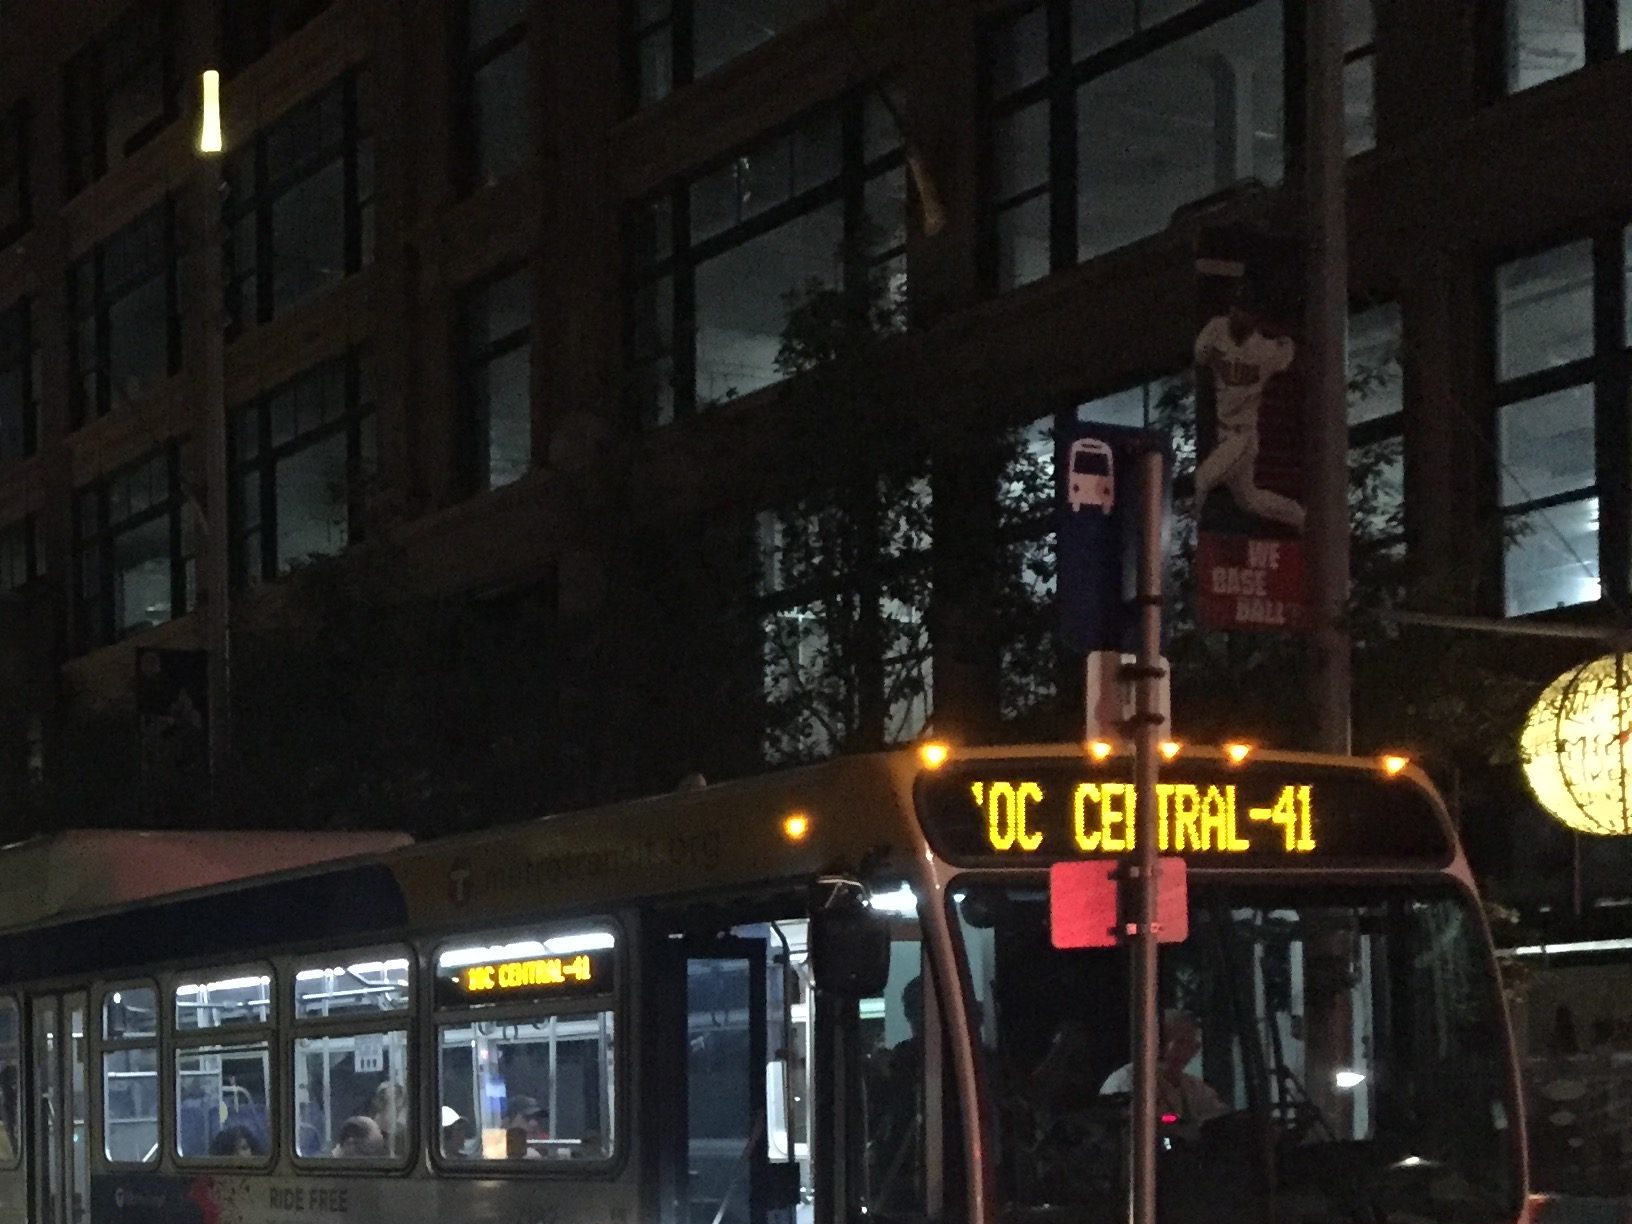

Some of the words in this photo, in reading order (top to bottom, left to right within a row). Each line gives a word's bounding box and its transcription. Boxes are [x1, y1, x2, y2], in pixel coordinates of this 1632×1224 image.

[1212, 567, 1267, 596] BASE
[1235, 598, 1285, 625] BALL
[270, 1186, 304, 1211] RIDE
[309, 1189, 348, 1212] FREE
